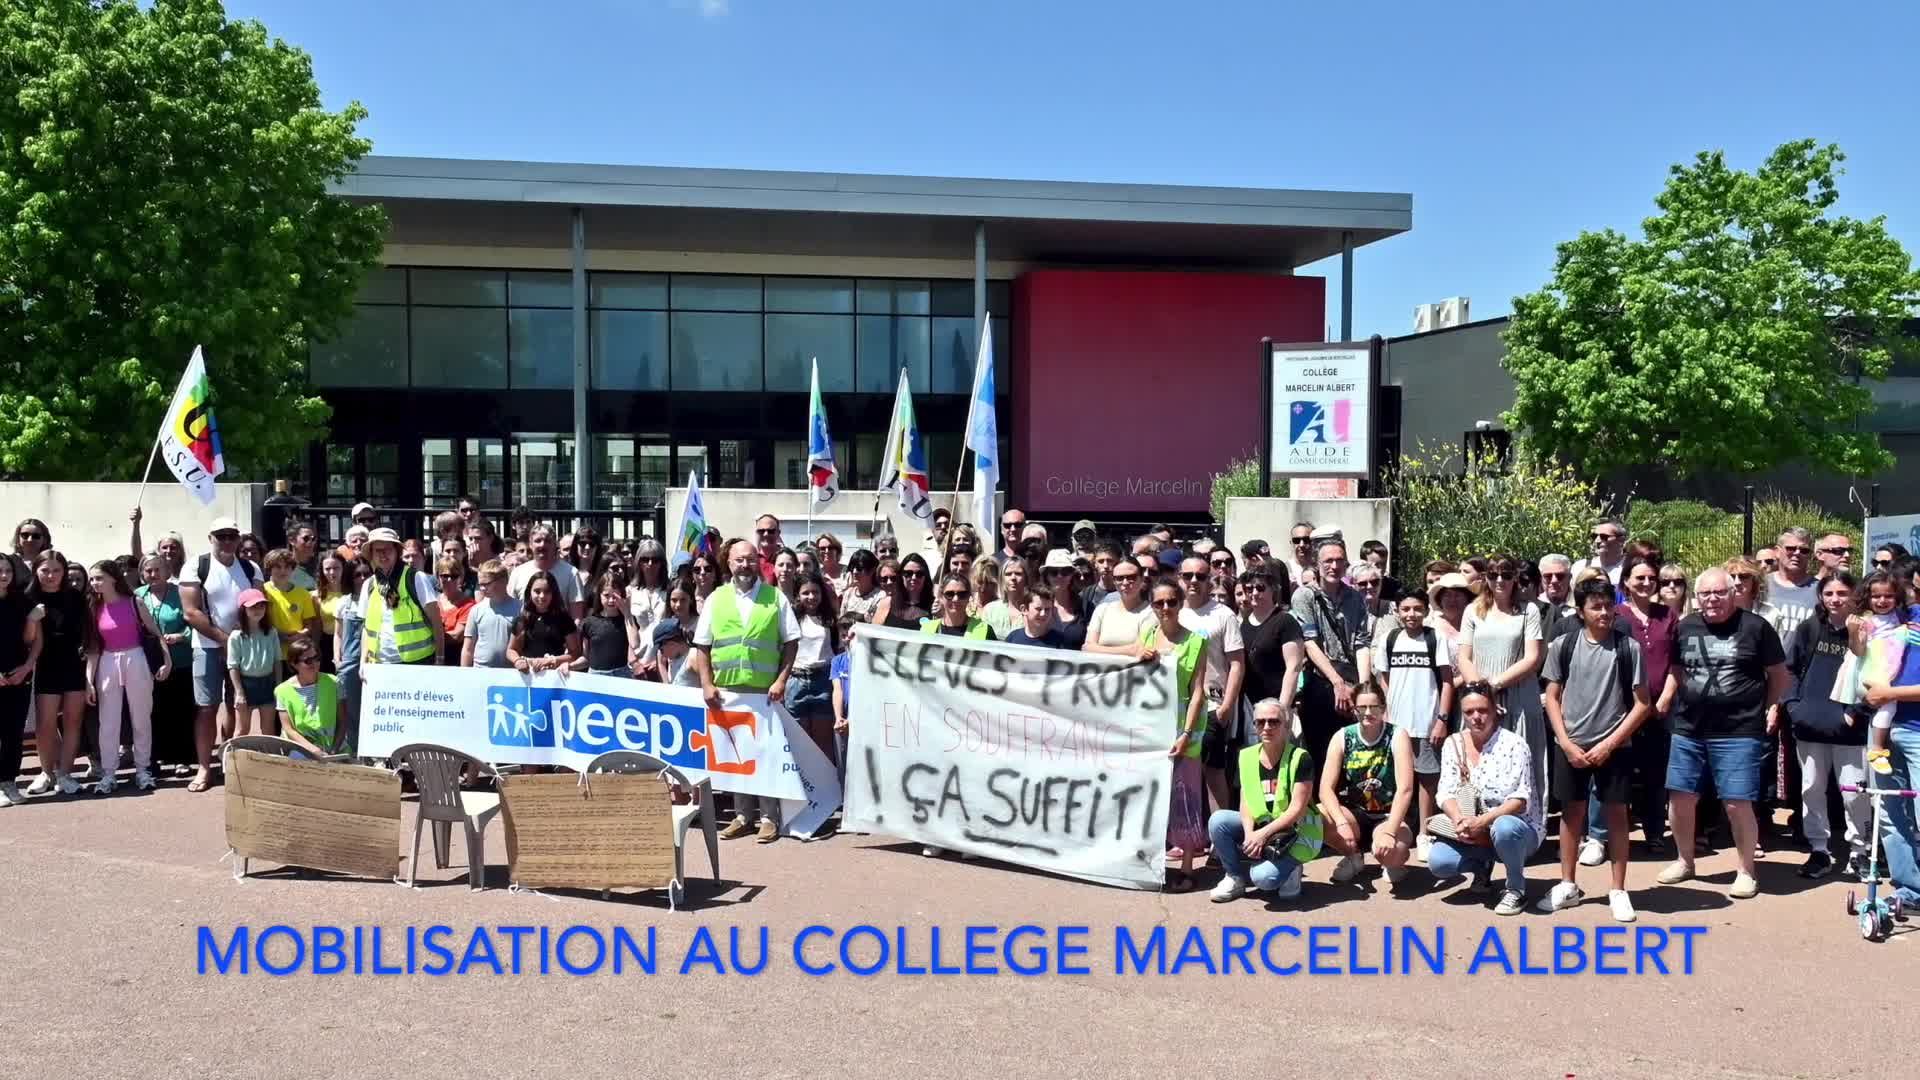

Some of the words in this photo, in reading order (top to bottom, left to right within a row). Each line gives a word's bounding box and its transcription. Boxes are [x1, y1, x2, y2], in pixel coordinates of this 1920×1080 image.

[1285, 384, 1325, 393] MARCELIN
[1326, 384, 1356, 392] ALBERT
[1290, 447, 1351, 457] AUDE
[1126, 476, 1203, 497] Marcelin
[1390, 653, 1431, 666] adidas
[1042, 658, 1170, 710] PROFS
[374, 690, 412, 703] parents
[373, 705, 386, 716] de
[388, 705, 465, 720] l'enseignement
[373, 721, 405, 734] public
[551, 698, 684, 760] peep
[883, 702, 922, 749] EN
[943, 705, 1146, 773] SOUFFRANCE
[901, 762, 971, 824] ÇA
